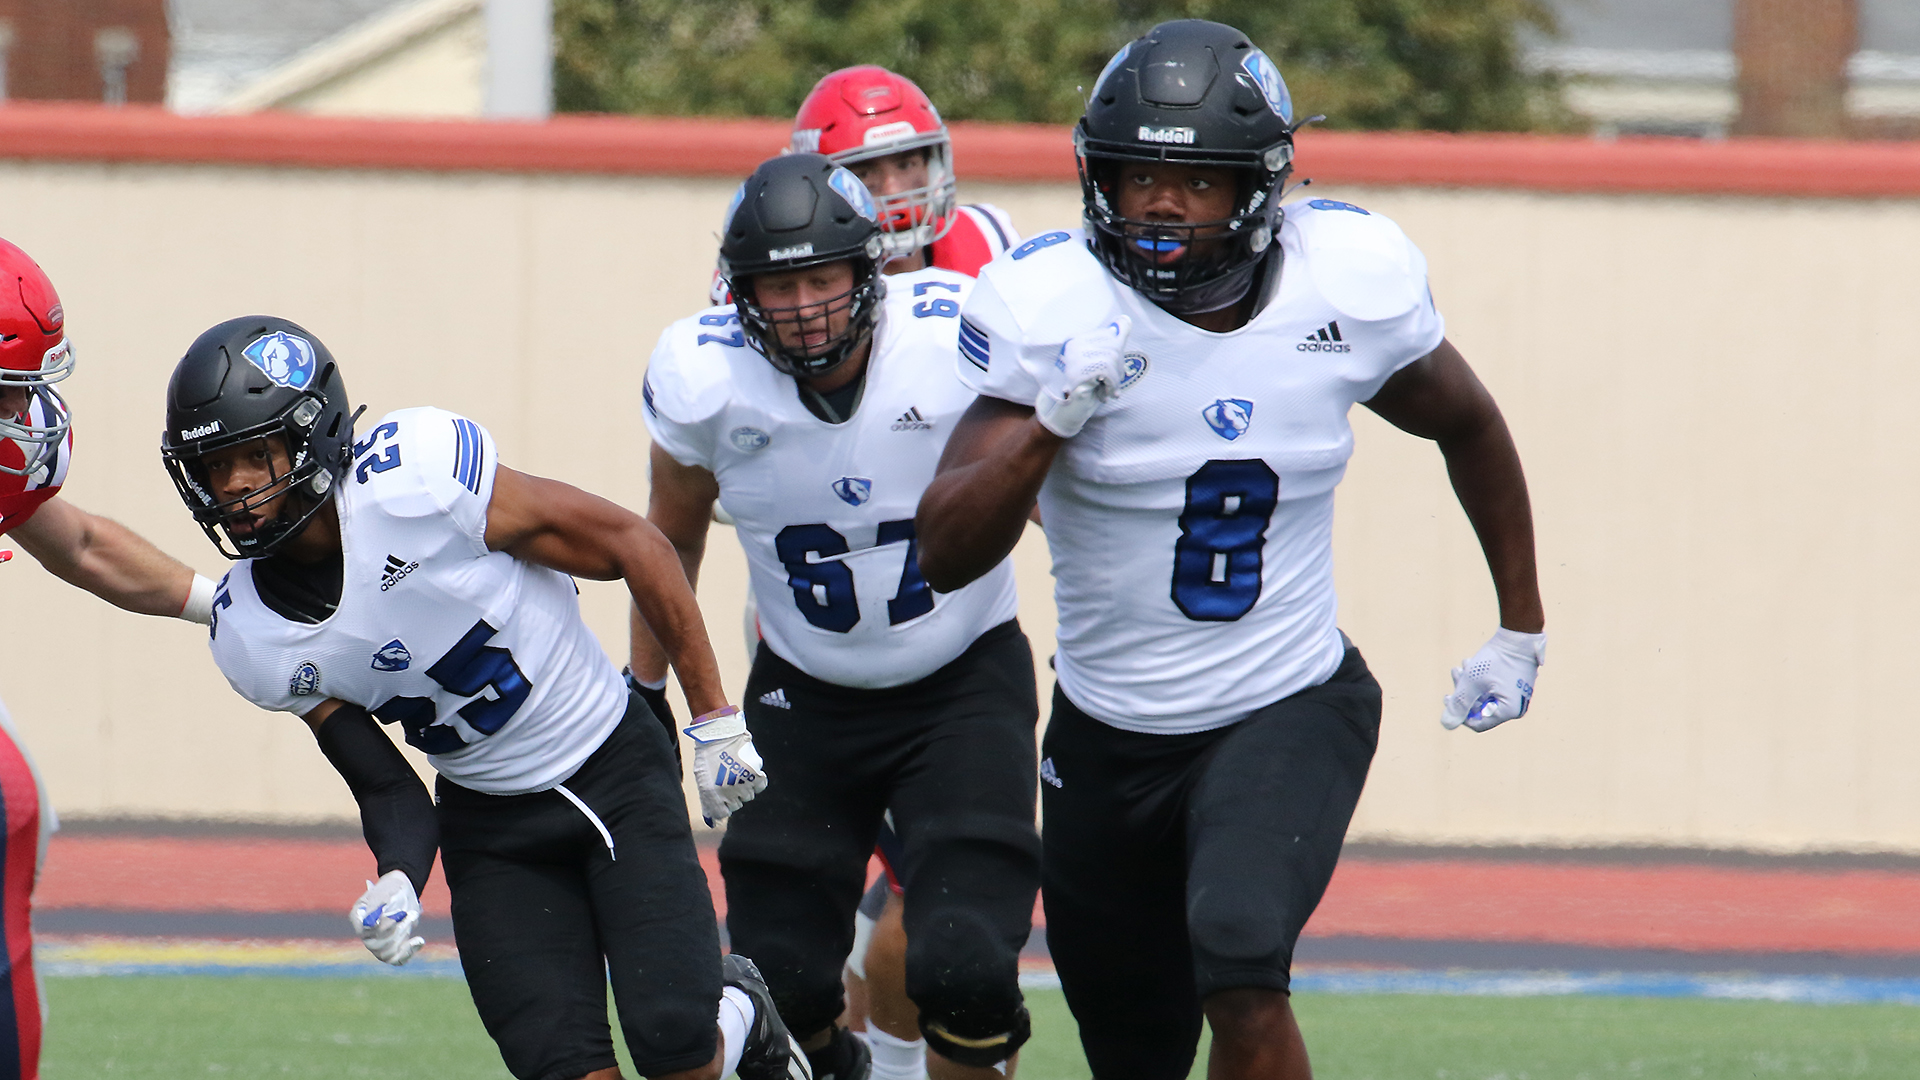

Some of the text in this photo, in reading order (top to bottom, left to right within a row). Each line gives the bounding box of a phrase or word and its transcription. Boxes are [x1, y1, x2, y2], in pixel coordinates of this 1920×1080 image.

[1138, 125, 1195, 144] Riddell
[1308, 199, 1371, 215] 8
[1011, 231, 1071, 260] 8
[912, 281, 961, 318] 67
[1296, 341, 1351, 354] adidas
[181, 420, 221, 441] Riddell
[353, 421, 402, 485] 25
[1170, 459, 1280, 622] 8
[380, 561, 420, 593] adidas
[774, 517, 936, 634] 67
[371, 617, 534, 756] 25
[718, 751, 756, 783] adidas
